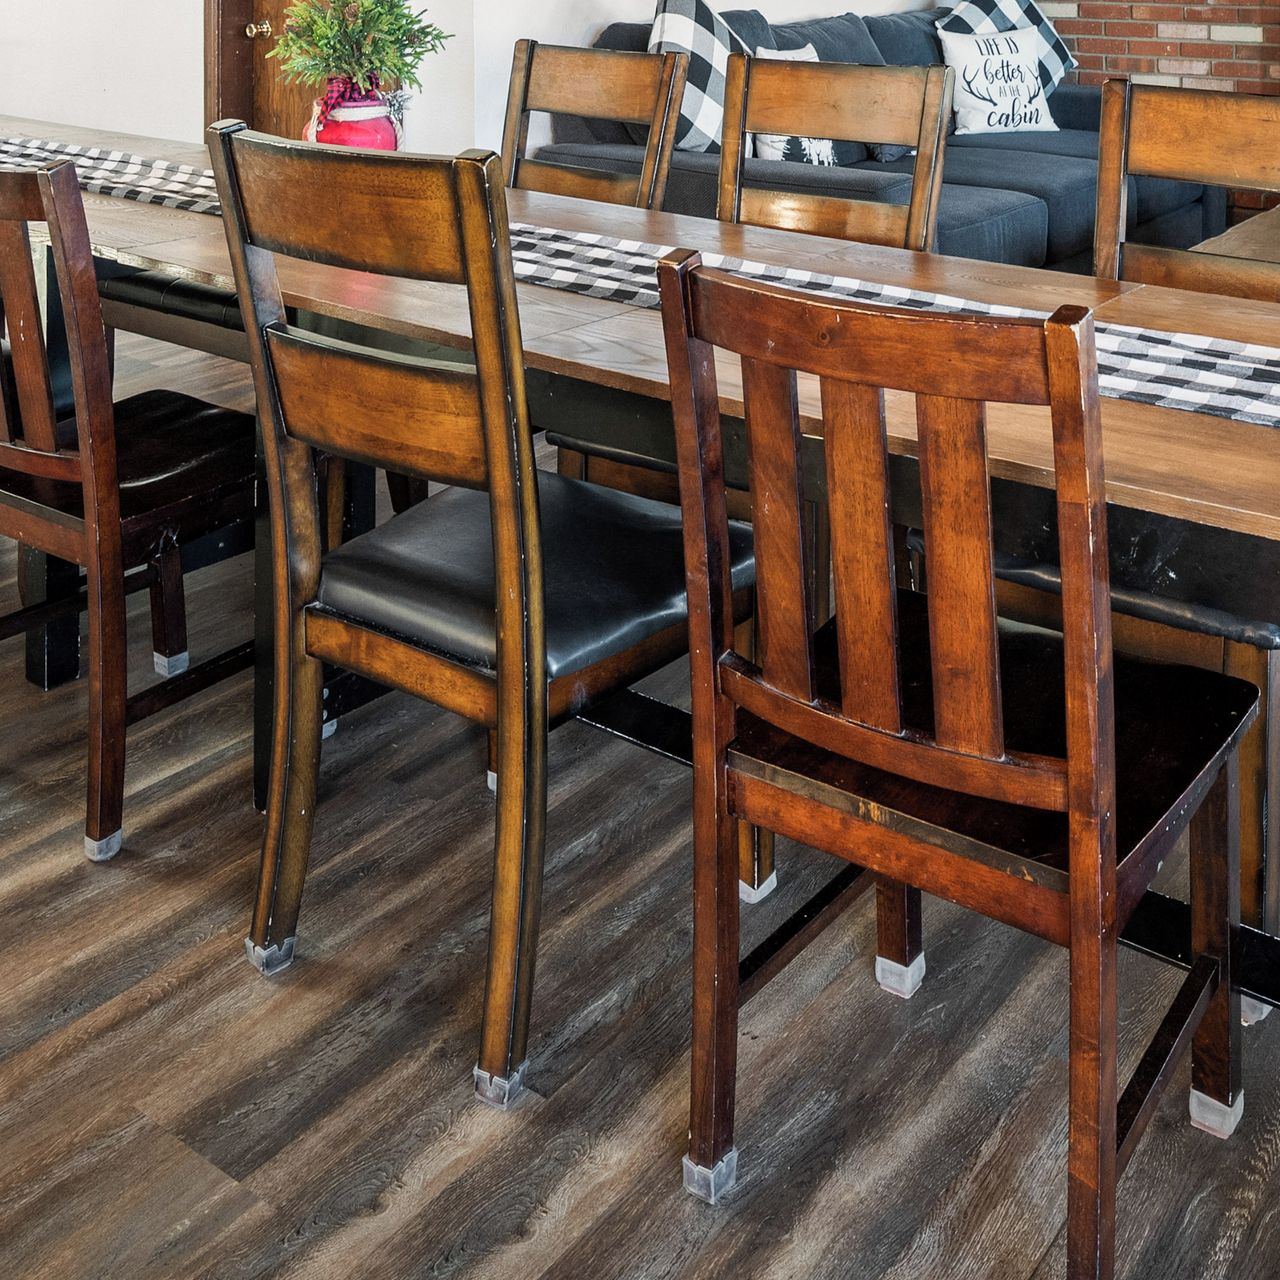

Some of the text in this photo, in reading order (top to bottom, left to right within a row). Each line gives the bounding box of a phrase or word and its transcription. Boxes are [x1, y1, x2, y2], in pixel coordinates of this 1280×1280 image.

[975, 37, 1019, 56] LIFE IS
[984, 58, 1025, 84] better
[987, 97, 1042, 128] cabin
